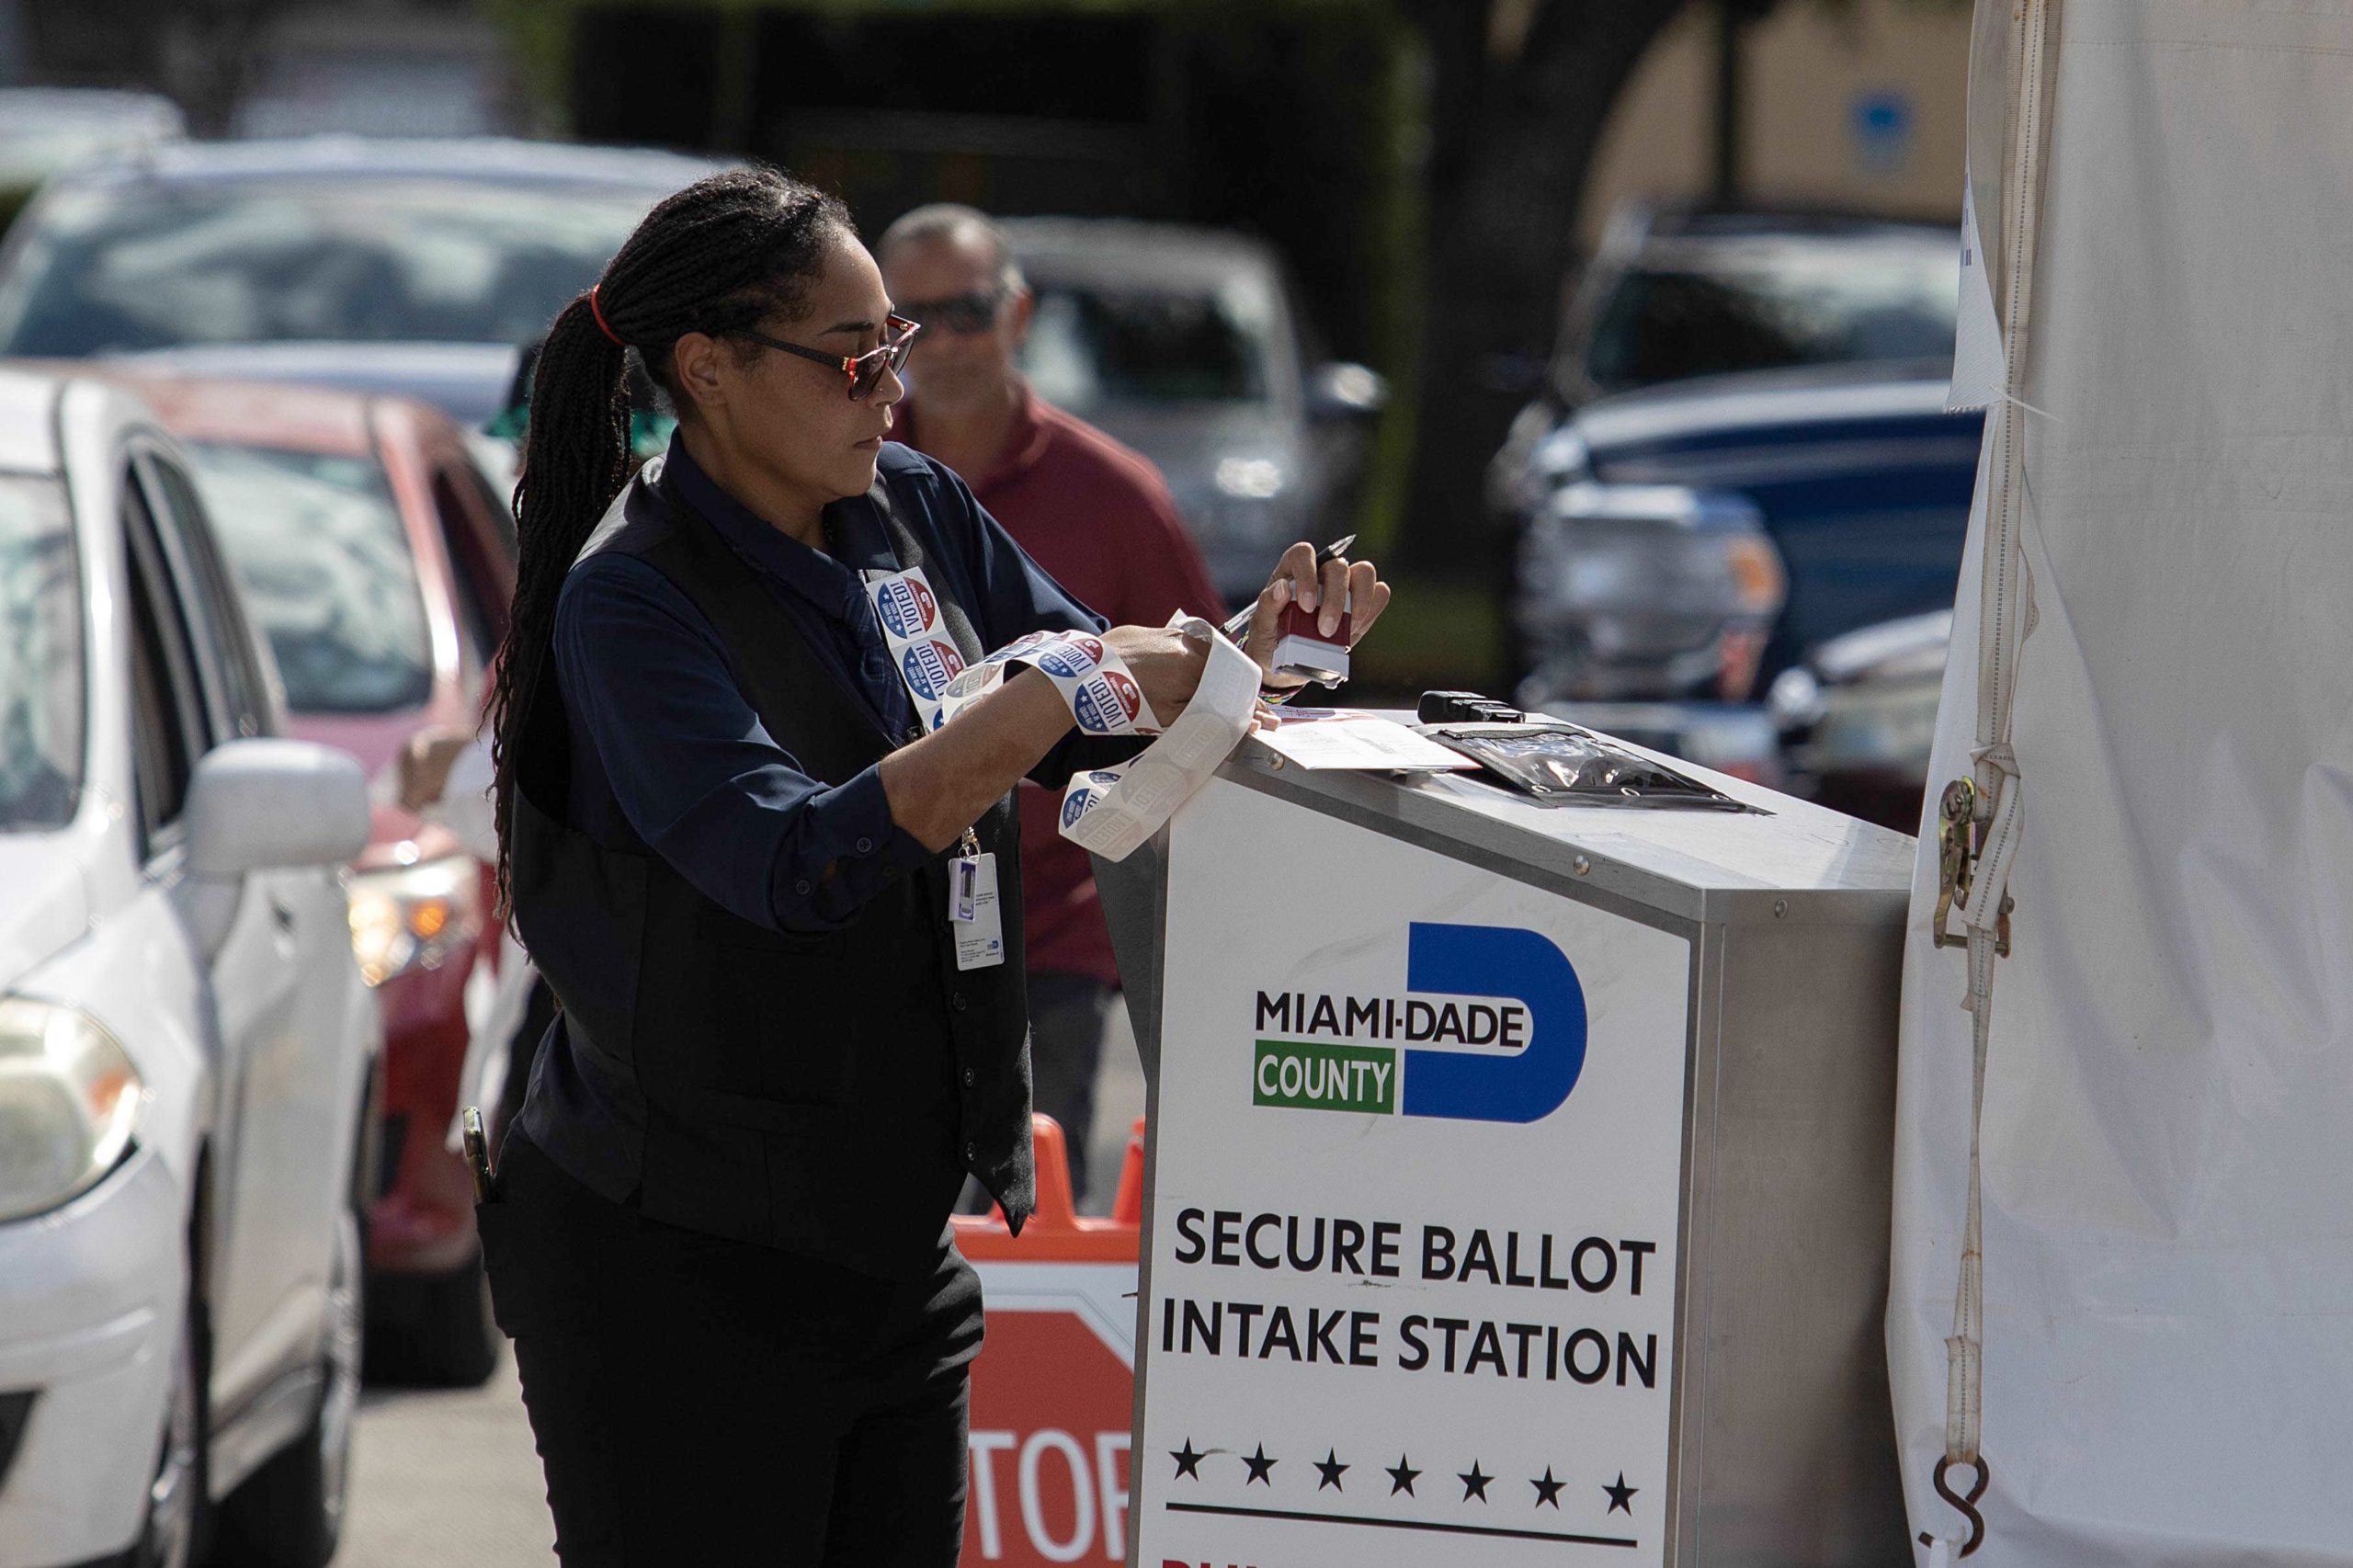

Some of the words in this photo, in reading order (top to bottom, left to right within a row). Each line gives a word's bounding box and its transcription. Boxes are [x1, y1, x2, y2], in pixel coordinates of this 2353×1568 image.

[890, 580, 920, 627] VOTED!
[908, 627, 923, 635] I
[915, 643, 948, 689] VOTED!
[1077, 662, 1092, 673] I
[1087, 676, 1122, 723] VOTED!
[1110, 720, 1126, 729] I
[1256, 991, 1524, 1048] MIAMI-DADE
[1257, 1054, 1392, 1103] COUNTY
[1176, 1208, 1402, 1277] SECURE
[1422, 1225, 1656, 1296] BALLOT
[1162, 1298, 1381, 1367] INTAKE
[1398, 1314, 1657, 1389] STATION
[968, 1428, 1131, 1562] TOP
